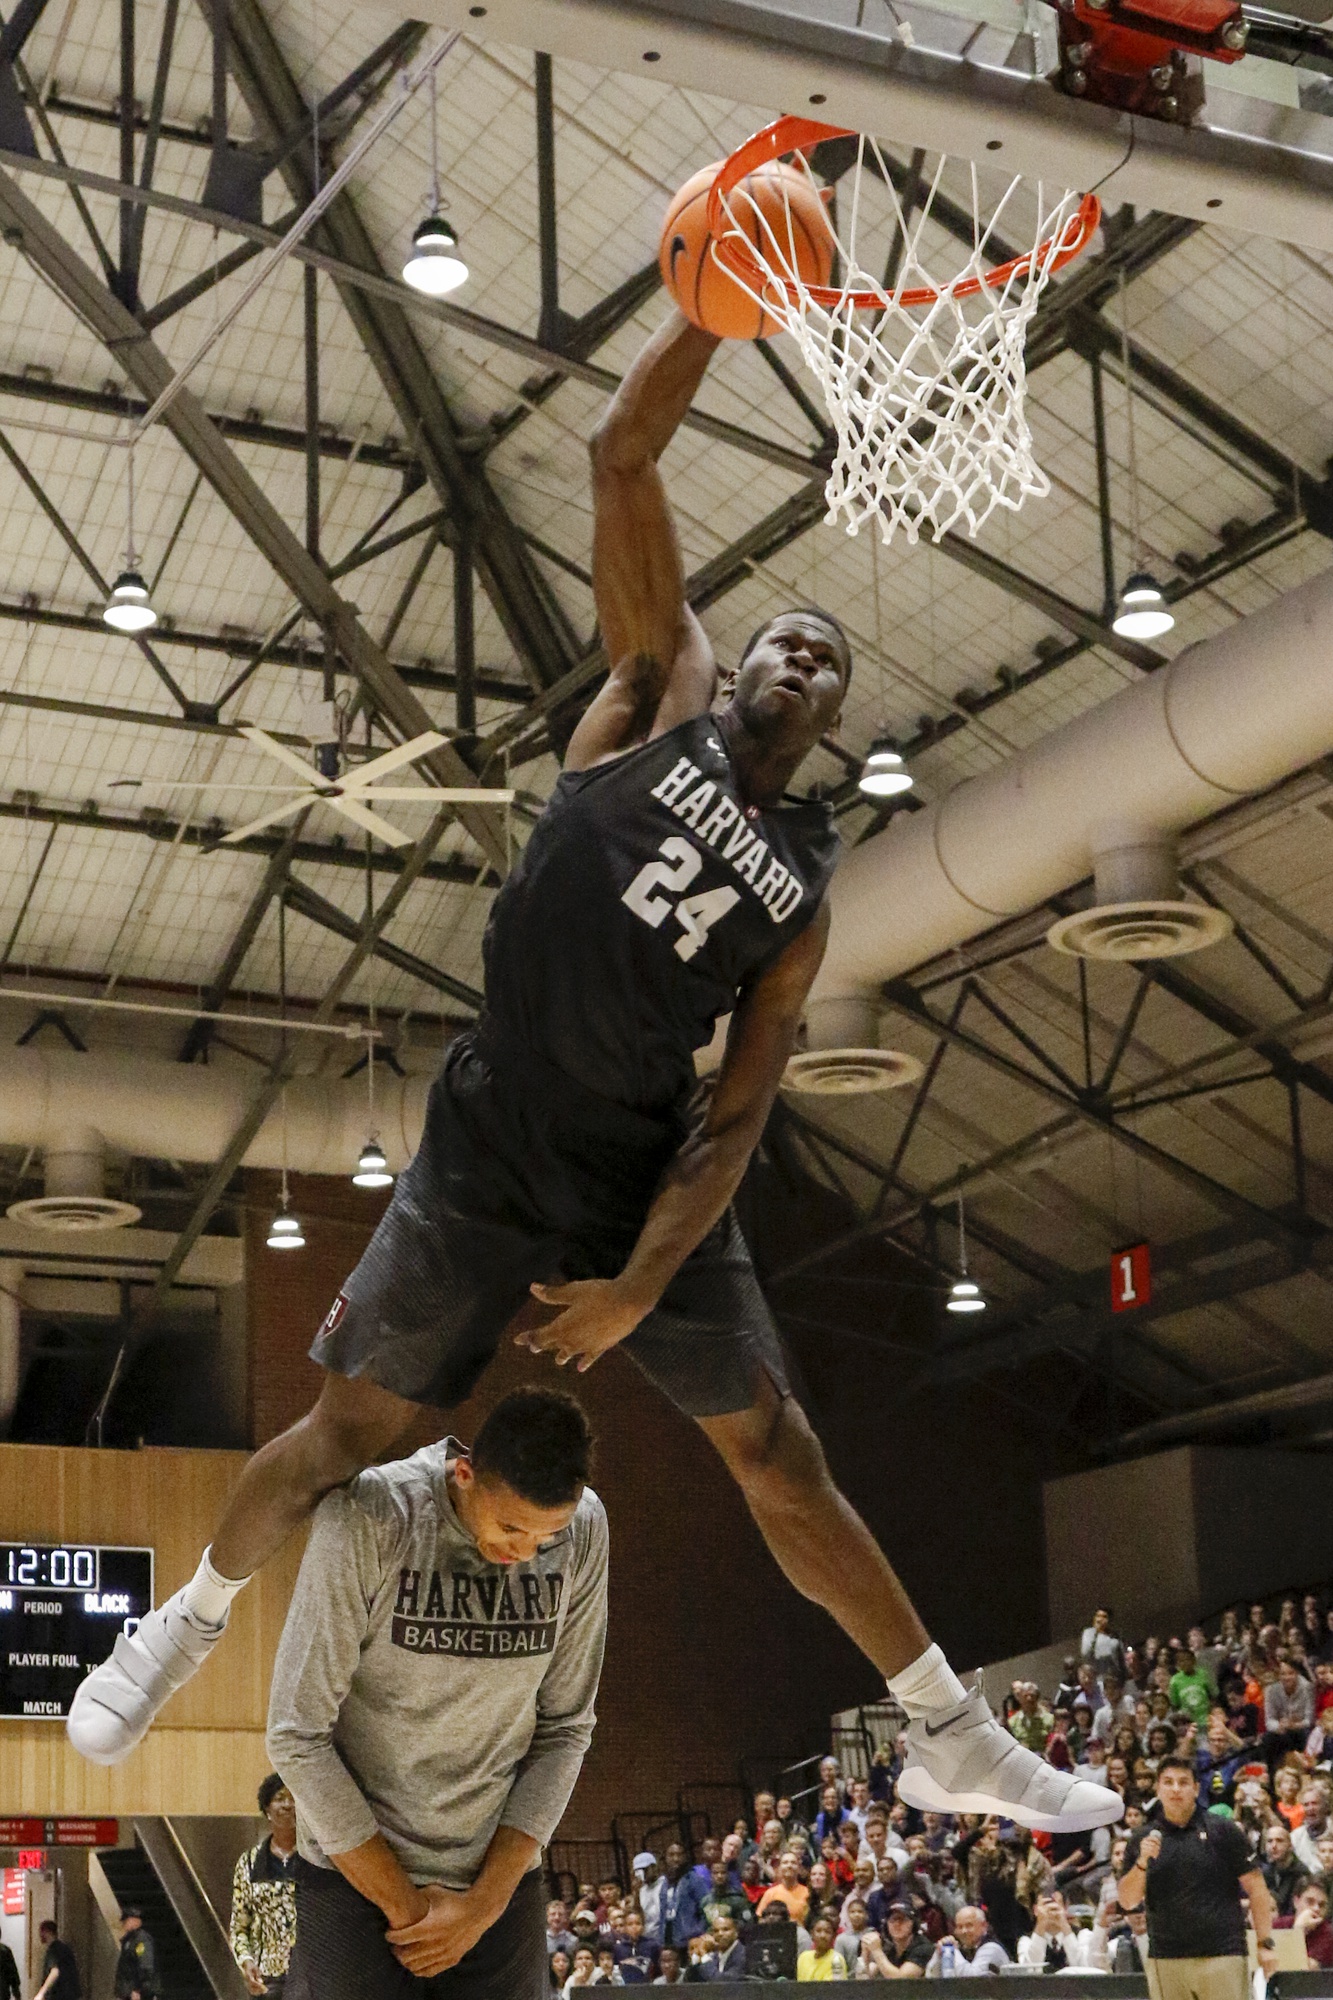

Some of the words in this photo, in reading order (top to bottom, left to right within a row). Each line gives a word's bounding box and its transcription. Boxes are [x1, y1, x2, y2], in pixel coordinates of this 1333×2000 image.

[650, 756, 804, 923] HARVARD
[621, 836, 742, 963] 24
[1120, 1256, 1136, 1302] 1
[8, 1549, 93, 1586] 12:00
[24, 1602, 63, 1614] PERIOD
[84, 1593, 130, 1613] BLACK
[394, 1568, 564, 1621] HARVARD
[403, 1625, 548, 1653] BASKETBALL
[9, 1653, 49, 1667] PLAYER
[52, 1654, 80, 1667] FOUL
[23, 1701, 61, 1714] MATCH
